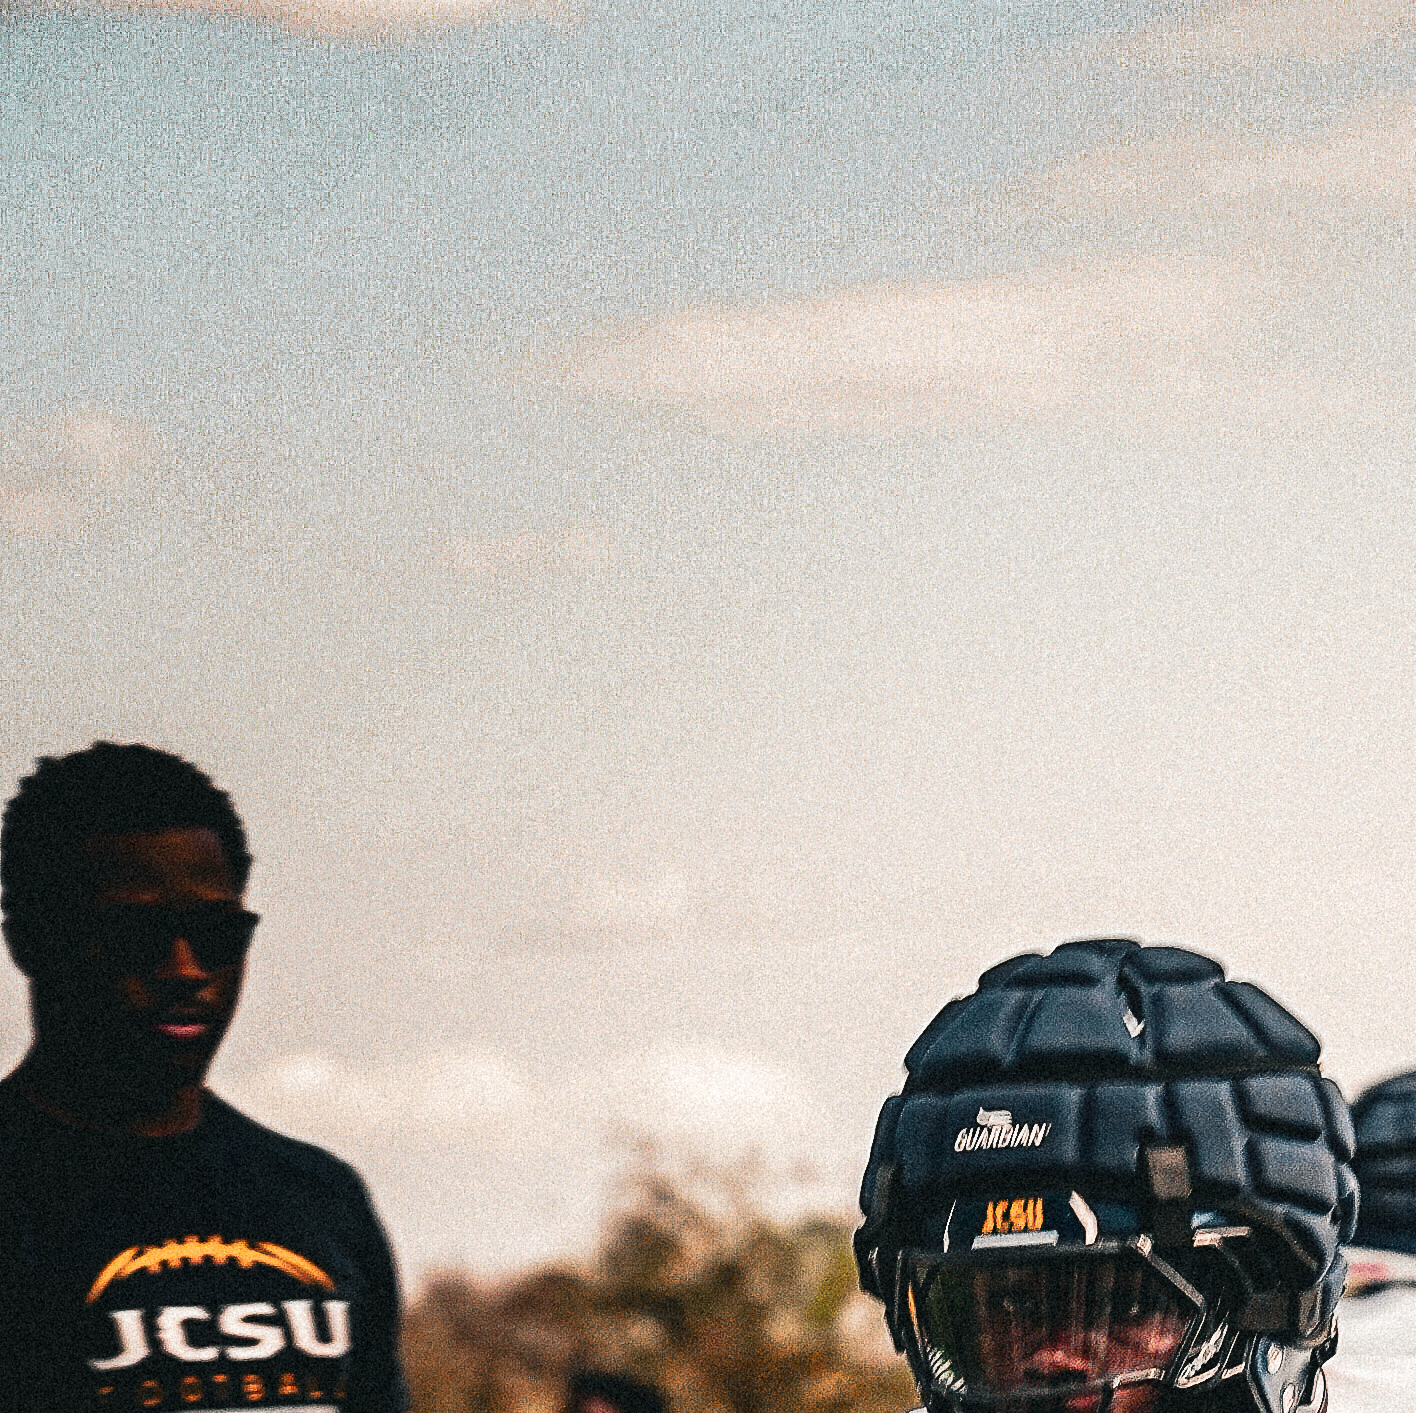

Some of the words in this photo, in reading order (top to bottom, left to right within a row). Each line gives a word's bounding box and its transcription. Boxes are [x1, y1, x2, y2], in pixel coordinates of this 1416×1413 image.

[954, 1122, 1046, 1152] GUARDIAN
[981, 1197, 1045, 1236] JCSU
[87, 1299, 352, 1371] JCSU
